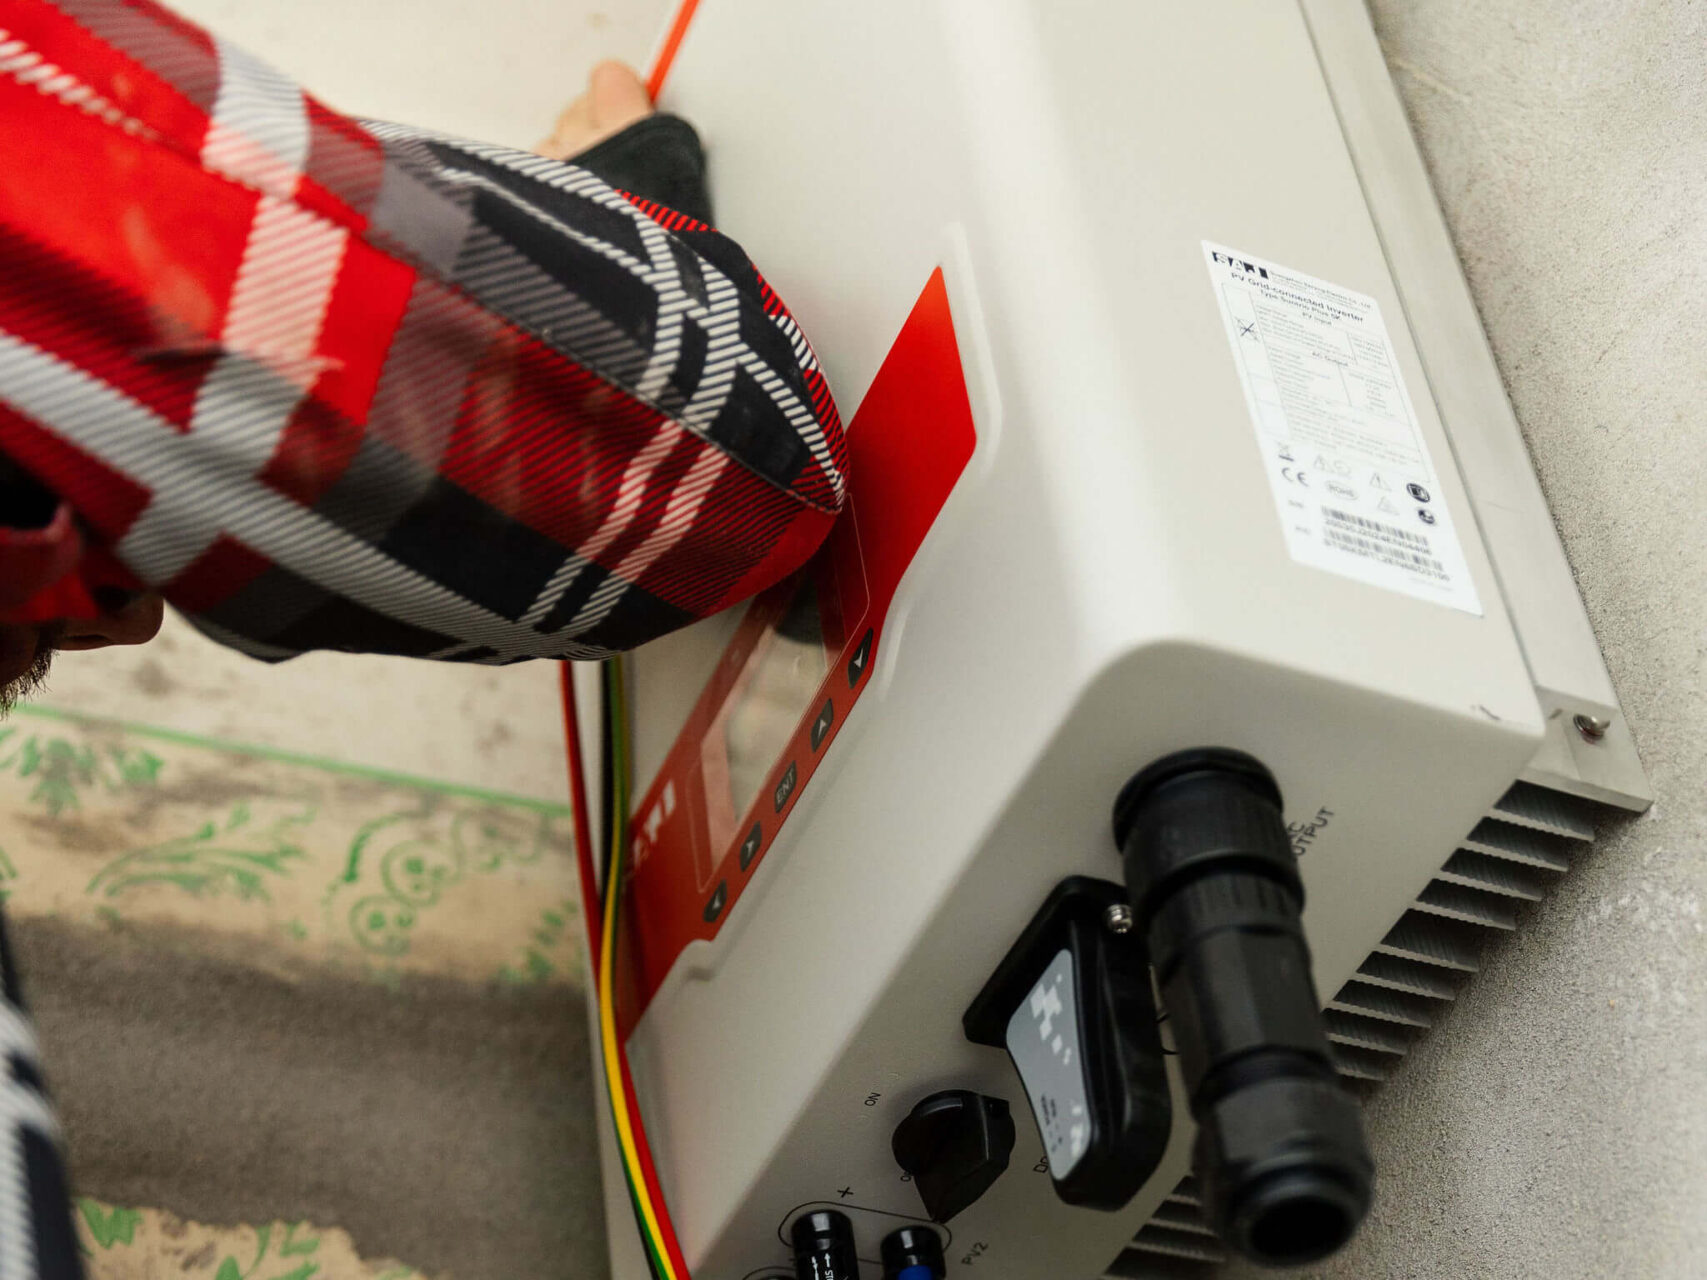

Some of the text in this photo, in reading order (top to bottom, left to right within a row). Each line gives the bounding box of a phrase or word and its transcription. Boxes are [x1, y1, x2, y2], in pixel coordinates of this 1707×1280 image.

[1231, 272, 1244, 282] PV
[1326, 304, 1364, 322] Inverter
[776, 768, 796, 805] ENT
[1291, 806, 1335, 856] UTPUT
[865, 1092, 881, 1107] ON
[961, 1241, 988, 1266] PV2
